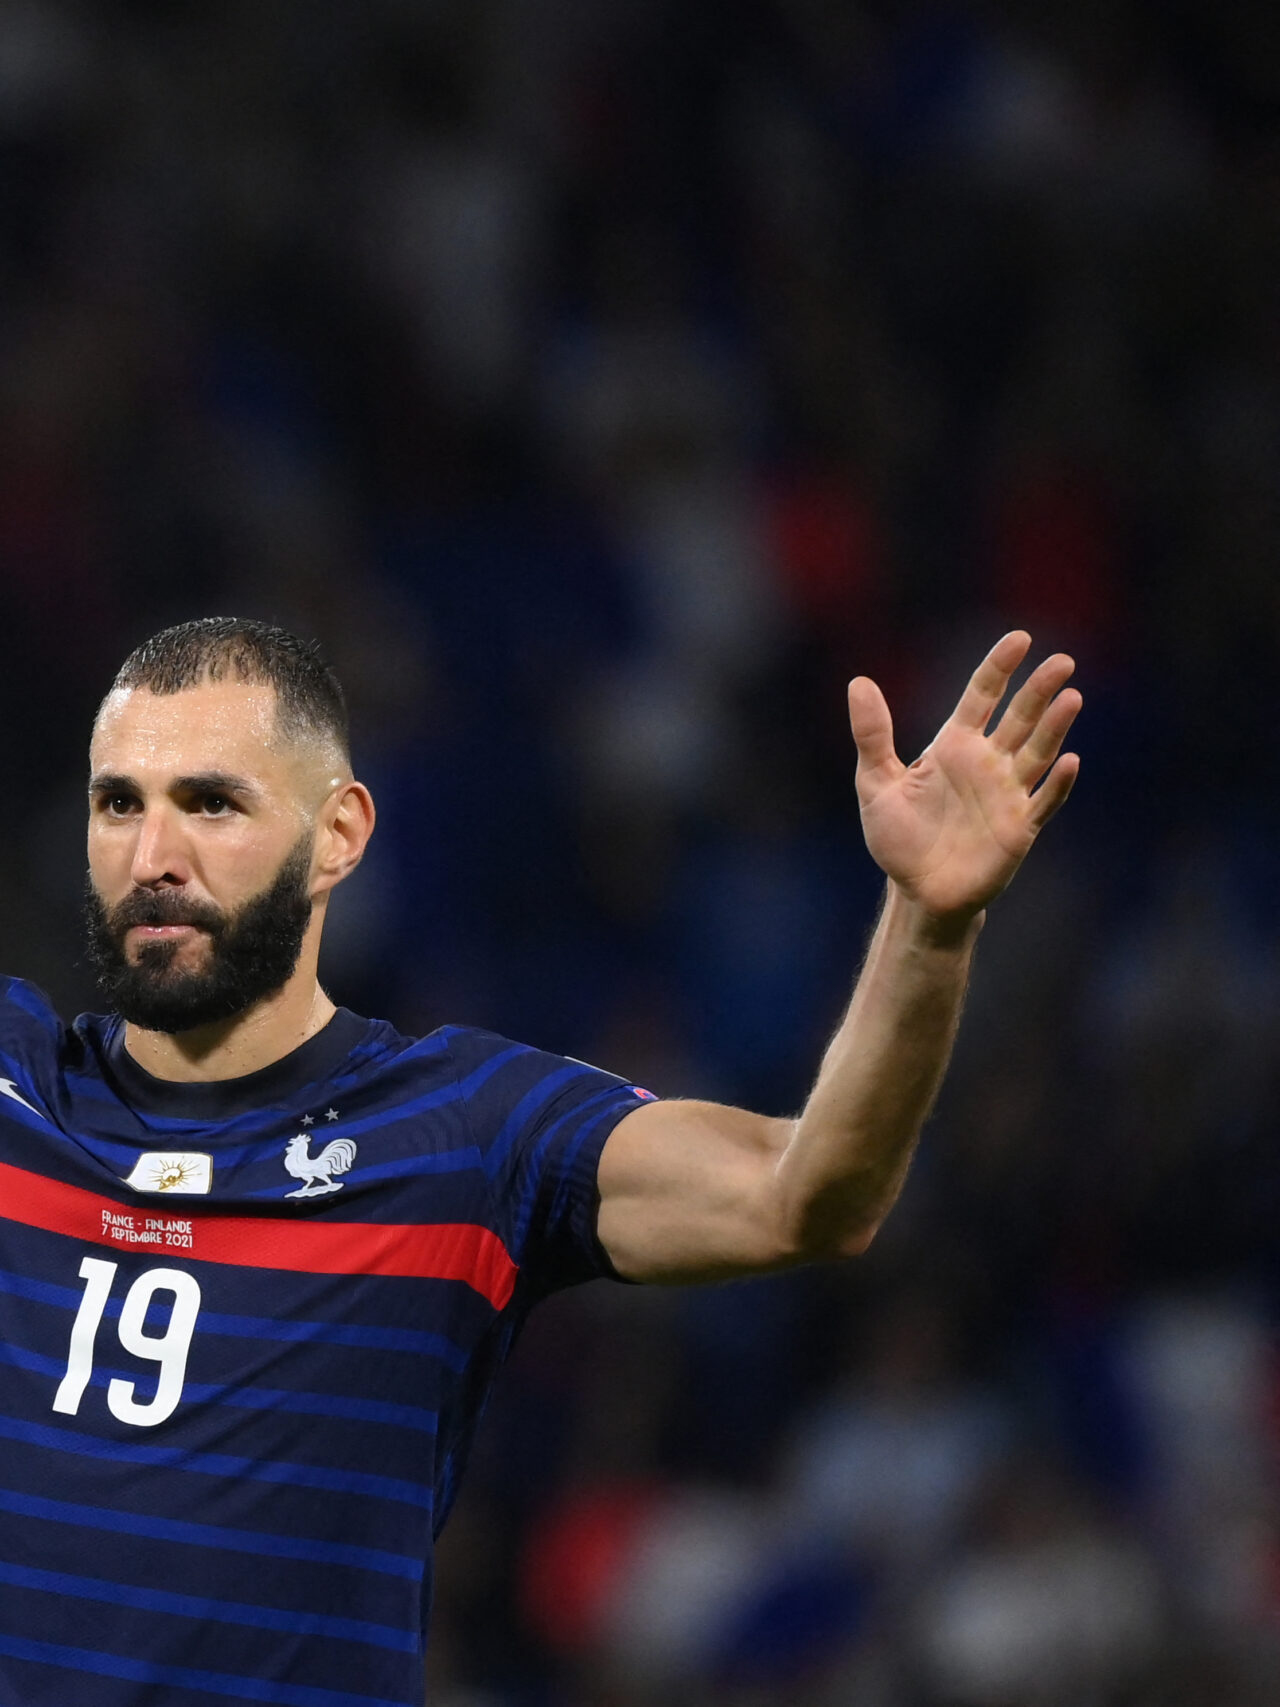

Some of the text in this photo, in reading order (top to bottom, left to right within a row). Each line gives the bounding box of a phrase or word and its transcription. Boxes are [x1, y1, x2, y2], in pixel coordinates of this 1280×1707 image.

[101, 1209, 134, 1229] FRANCE
[145, 1218, 193, 1234] FINLANDE
[101, 1223, 193, 1248] 7 SEPTEMBRE 2021
[52, 1256, 202, 1427] 19
